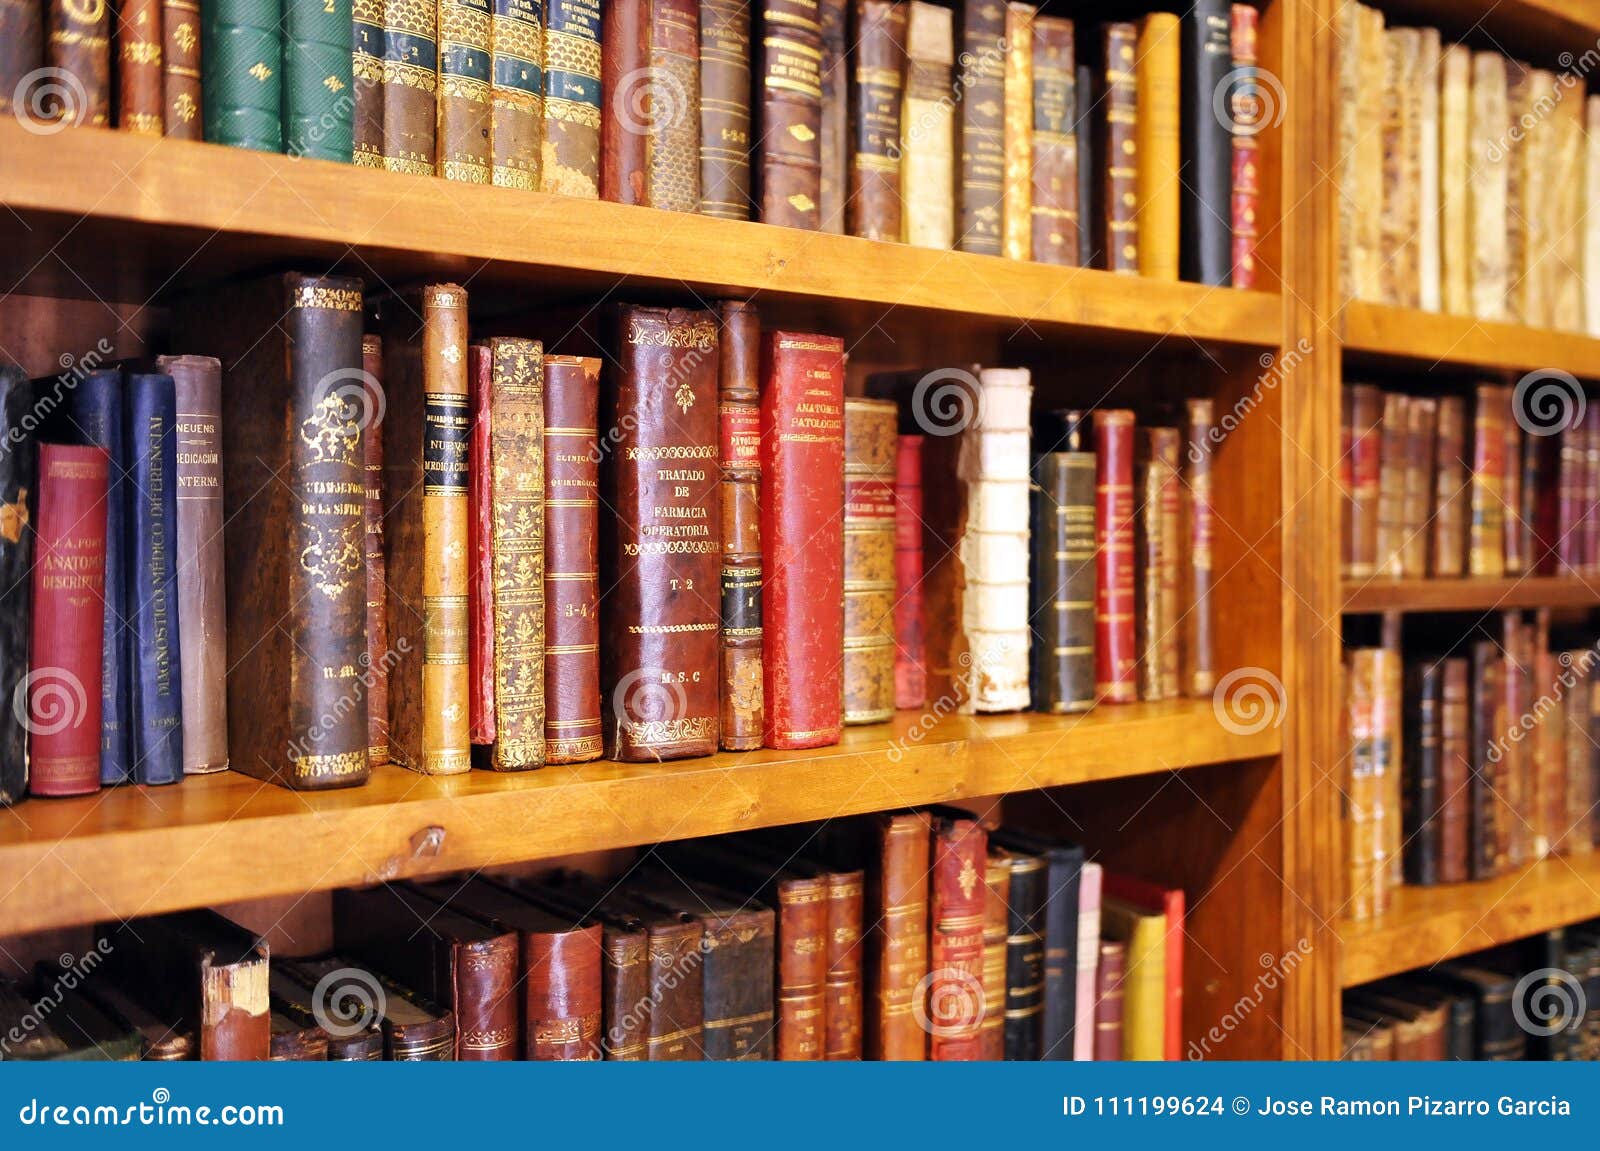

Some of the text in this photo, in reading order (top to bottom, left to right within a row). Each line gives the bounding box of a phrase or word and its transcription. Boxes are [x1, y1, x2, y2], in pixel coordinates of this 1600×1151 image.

[176, 424, 215, 433] NEUENS
[657, 469, 706, 481] TRATADO
[674, 486, 690, 498] DE
[653, 506, 707, 519] FARMACIA
[641, 524, 710, 537] OPERATORIA
[686, 578, 694, 590] 2
[564, 603, 588, 617] 3-4
